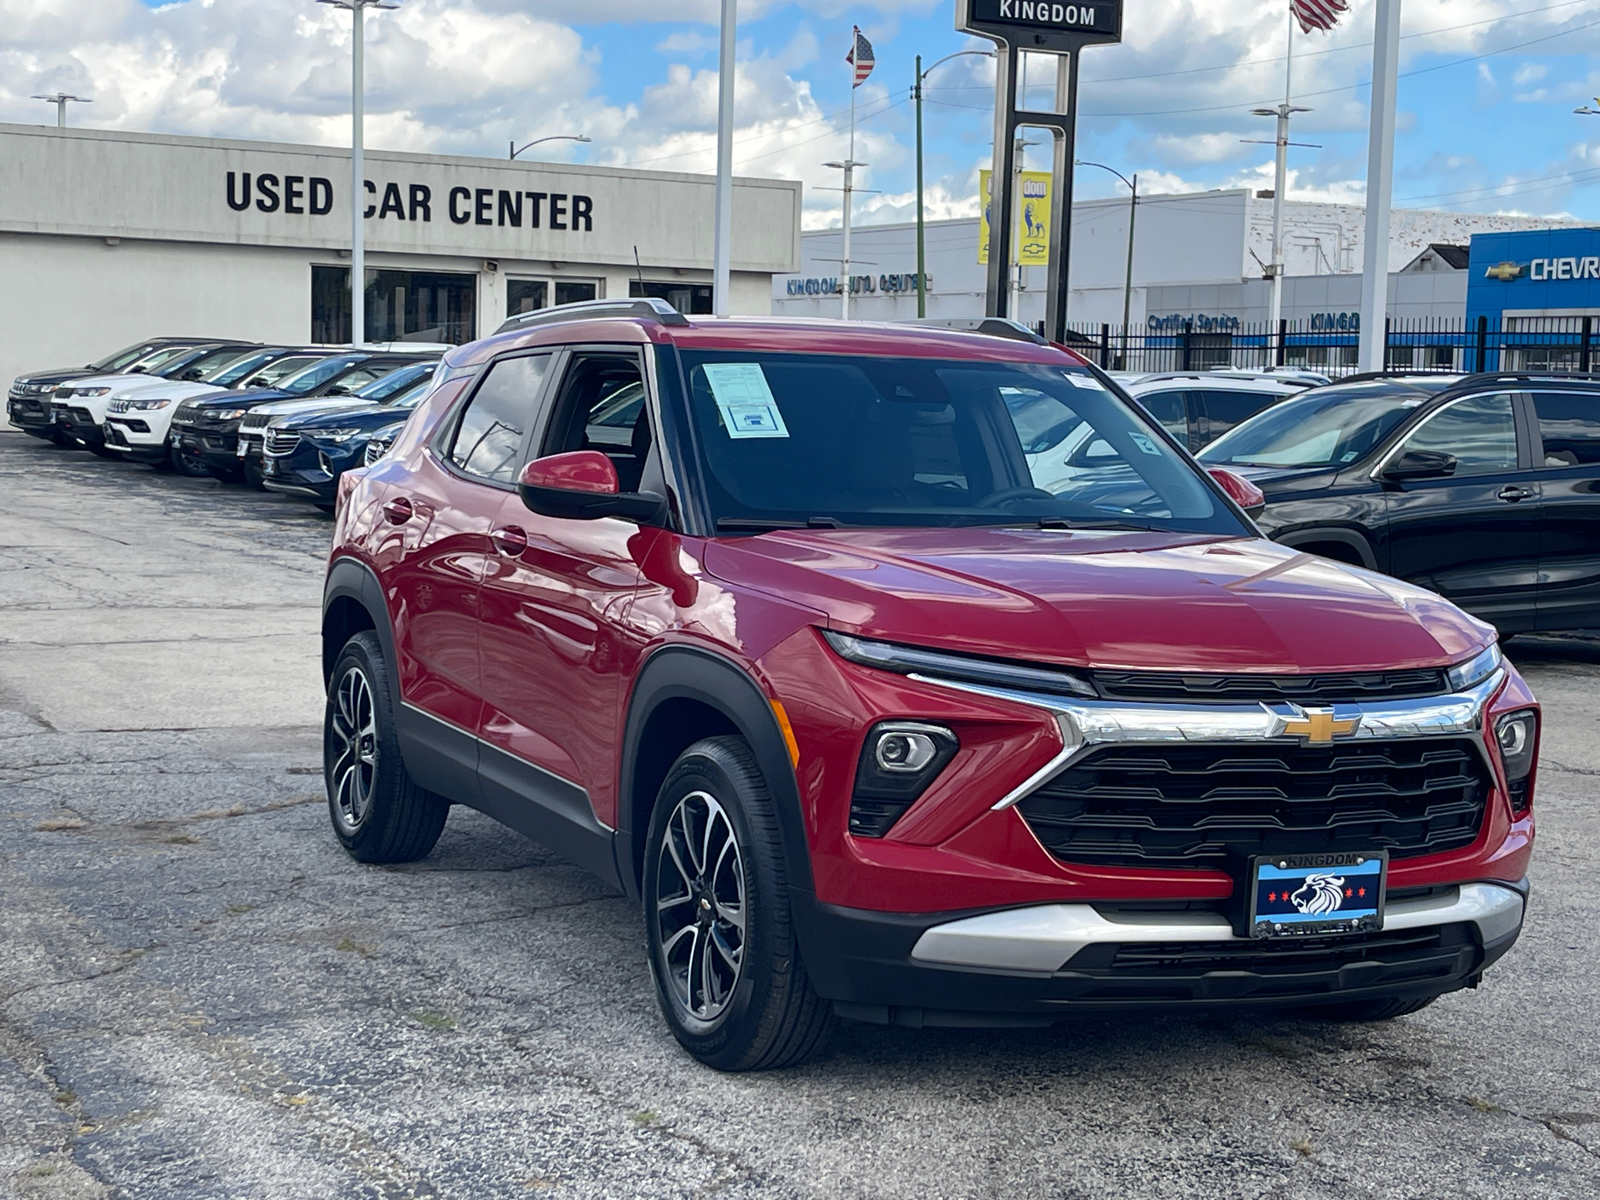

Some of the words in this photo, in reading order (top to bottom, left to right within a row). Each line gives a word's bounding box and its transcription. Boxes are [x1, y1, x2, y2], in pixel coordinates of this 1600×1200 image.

[999, 0, 1095, 26] KINGDOM
[1023, 178, 1047, 198] dom
[226, 171, 334, 216] USED
[363, 180, 432, 222] CAR
[448, 186, 594, 232] CENTER
[1530, 256, 1600, 280] CHEVR
[847, 275, 876, 293] UTO
[879, 273, 933, 293] CENTE
[1310, 311, 1360, 330] KINGD
[1287, 853, 1357, 867] KINGDOM
